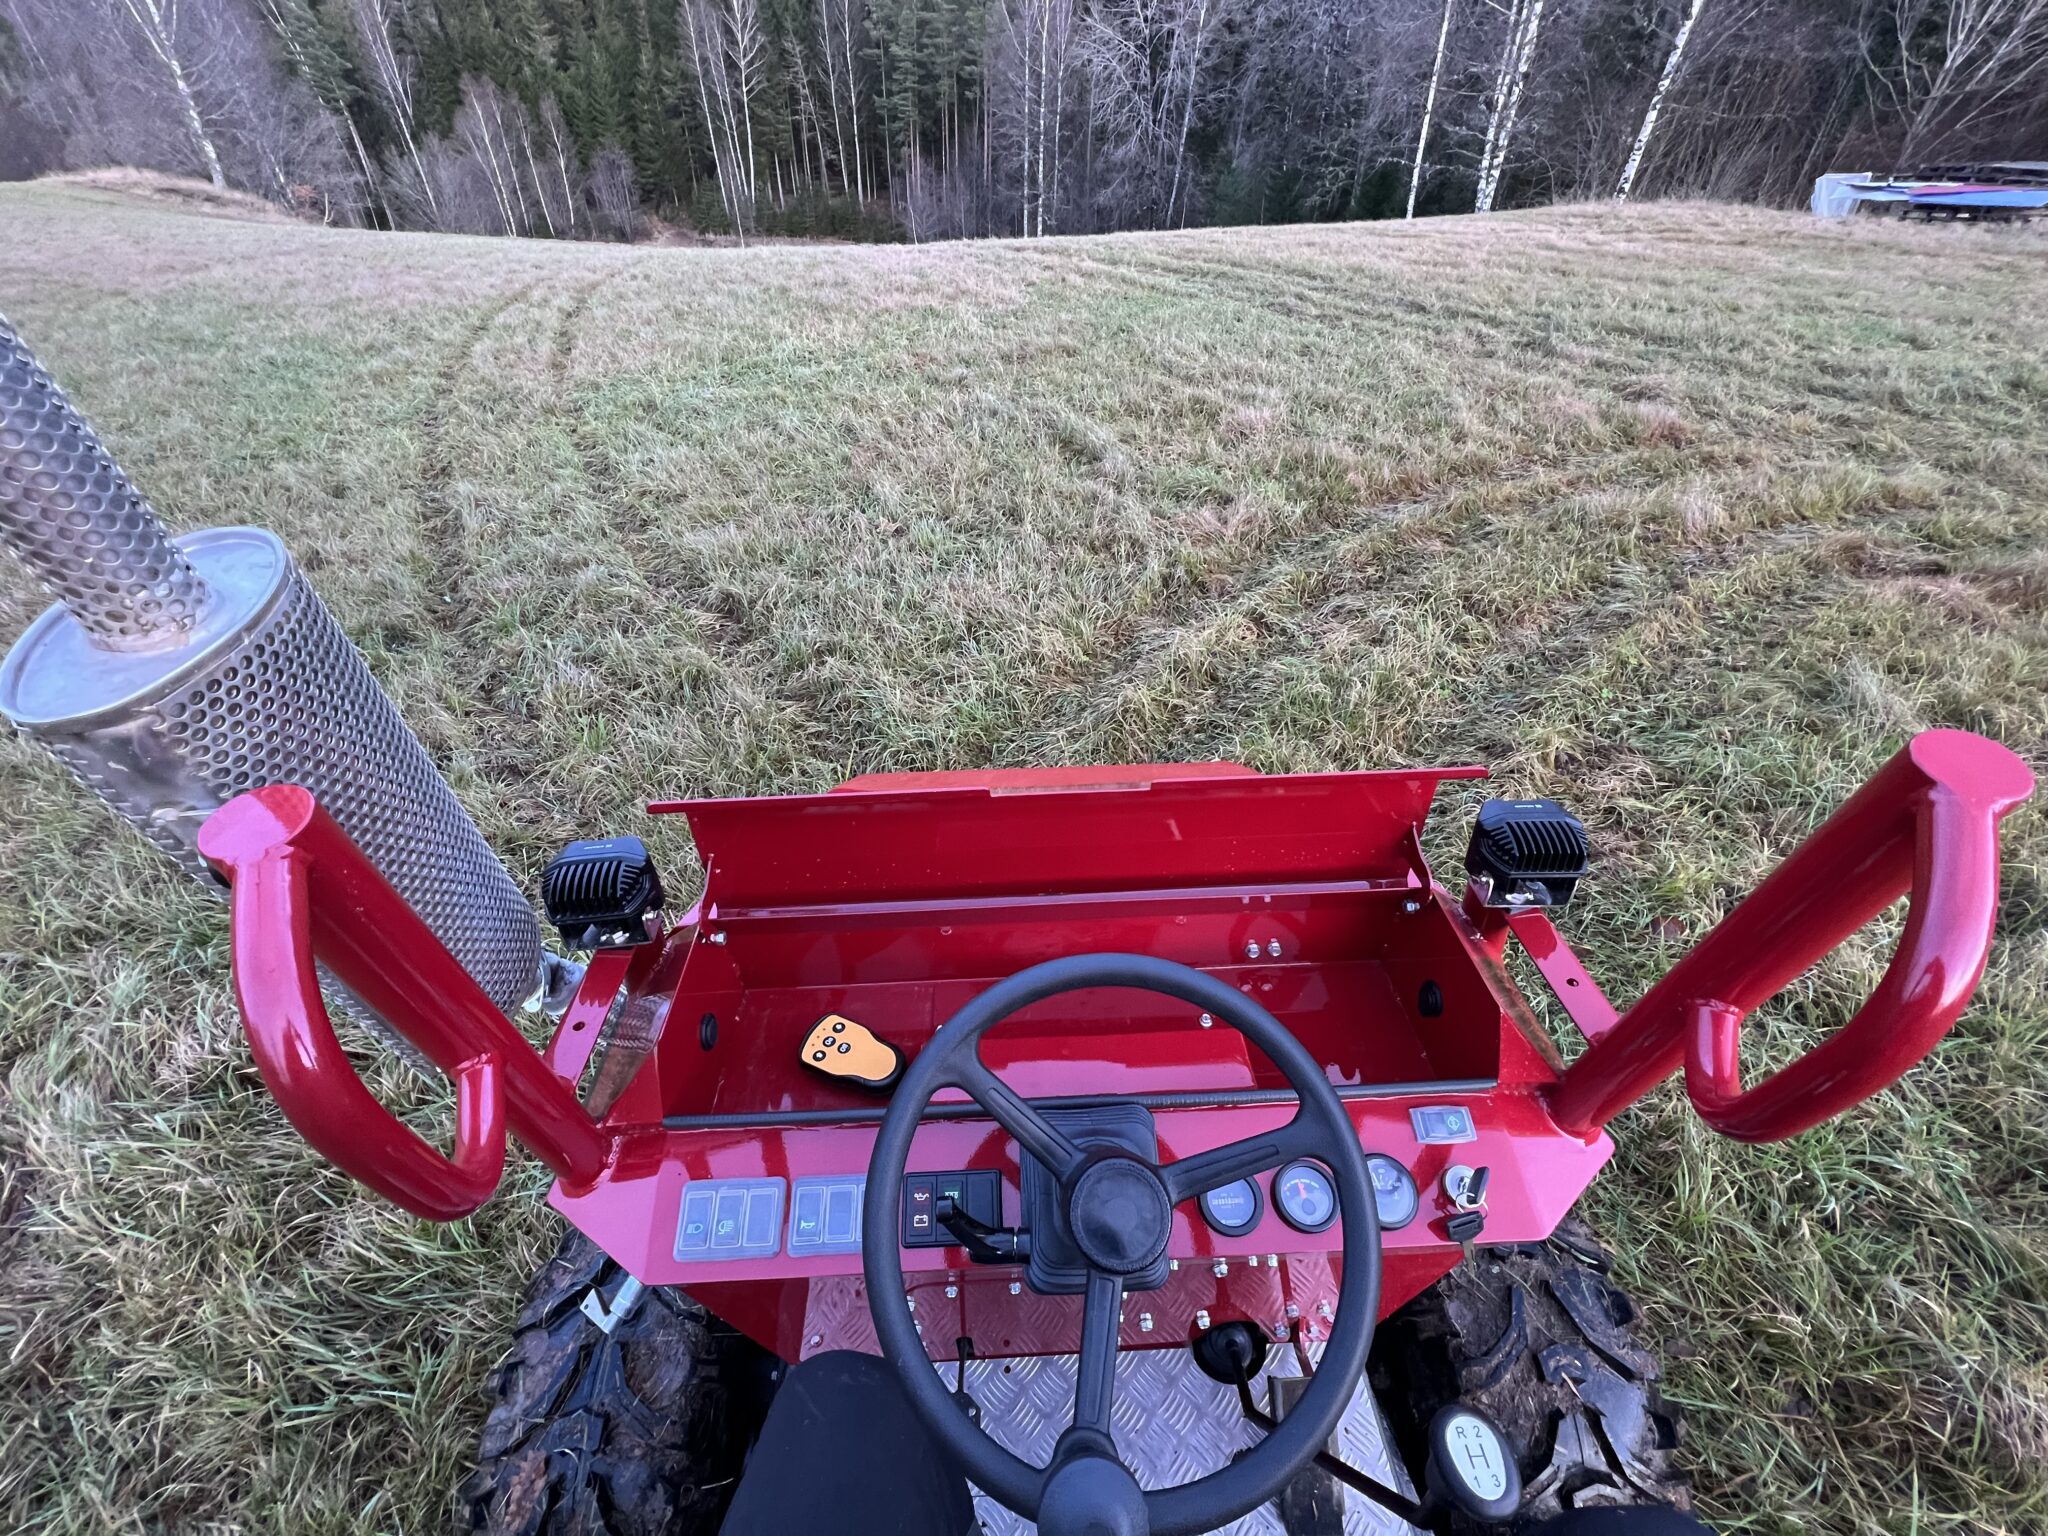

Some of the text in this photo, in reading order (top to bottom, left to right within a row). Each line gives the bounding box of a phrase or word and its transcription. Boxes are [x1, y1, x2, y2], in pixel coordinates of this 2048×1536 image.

[1455, 1425, 1482, 1439] R 2
[1473, 1474, 1501, 1489] 1 3
